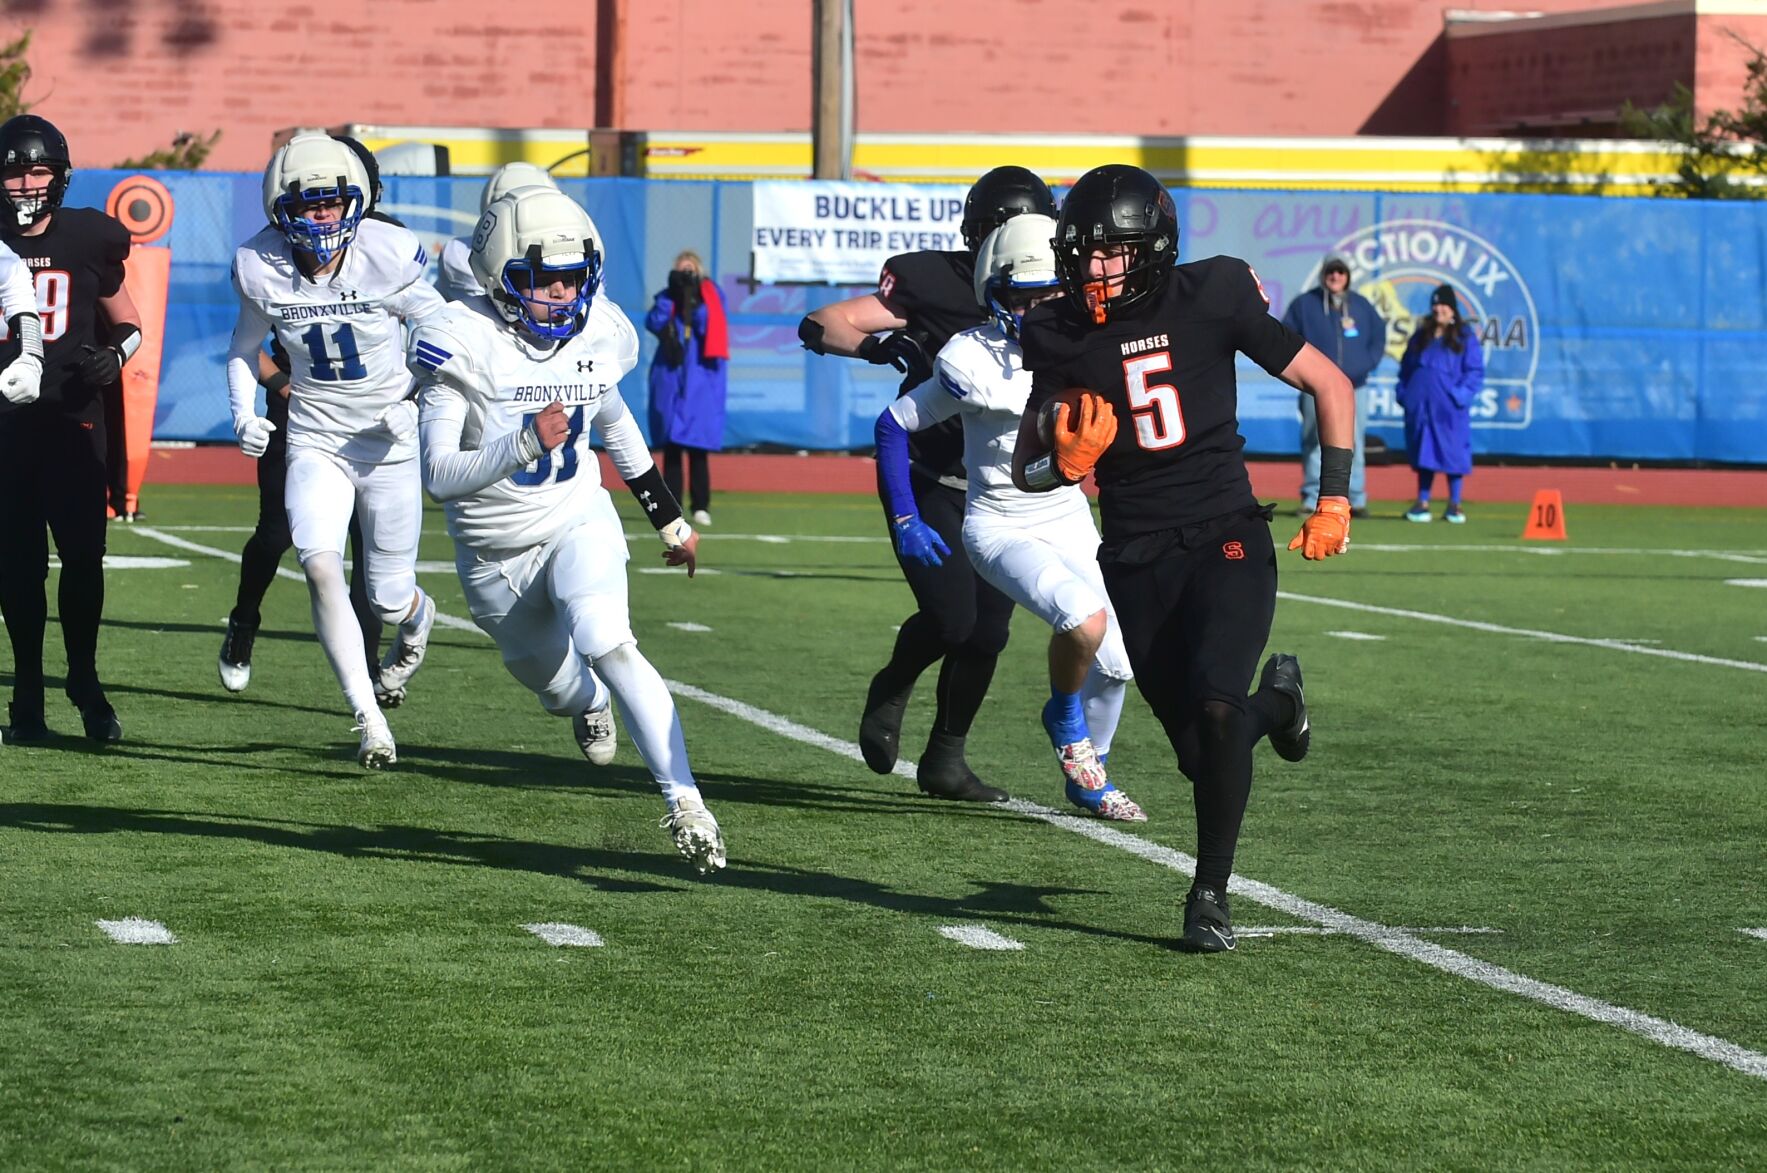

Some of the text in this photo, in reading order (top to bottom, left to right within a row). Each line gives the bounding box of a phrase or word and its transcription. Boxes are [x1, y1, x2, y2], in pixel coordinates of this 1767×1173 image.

[815, 195, 962, 222] BUCKLE UP
[756, 227, 826, 248] EVERY
[888, 231, 957, 251] EVERY
[1467, 253, 1510, 297] IX
[280, 303, 371, 321] BRONXVILLE
[301, 322, 368, 381] 11
[1120, 334, 1170, 356] HORSES
[513, 383, 607, 402] BRONXVILLE
[1122, 351, 1187, 451] 5
[1535, 503, 1557, 528] 10
[1222, 541, 1245, 560] S
